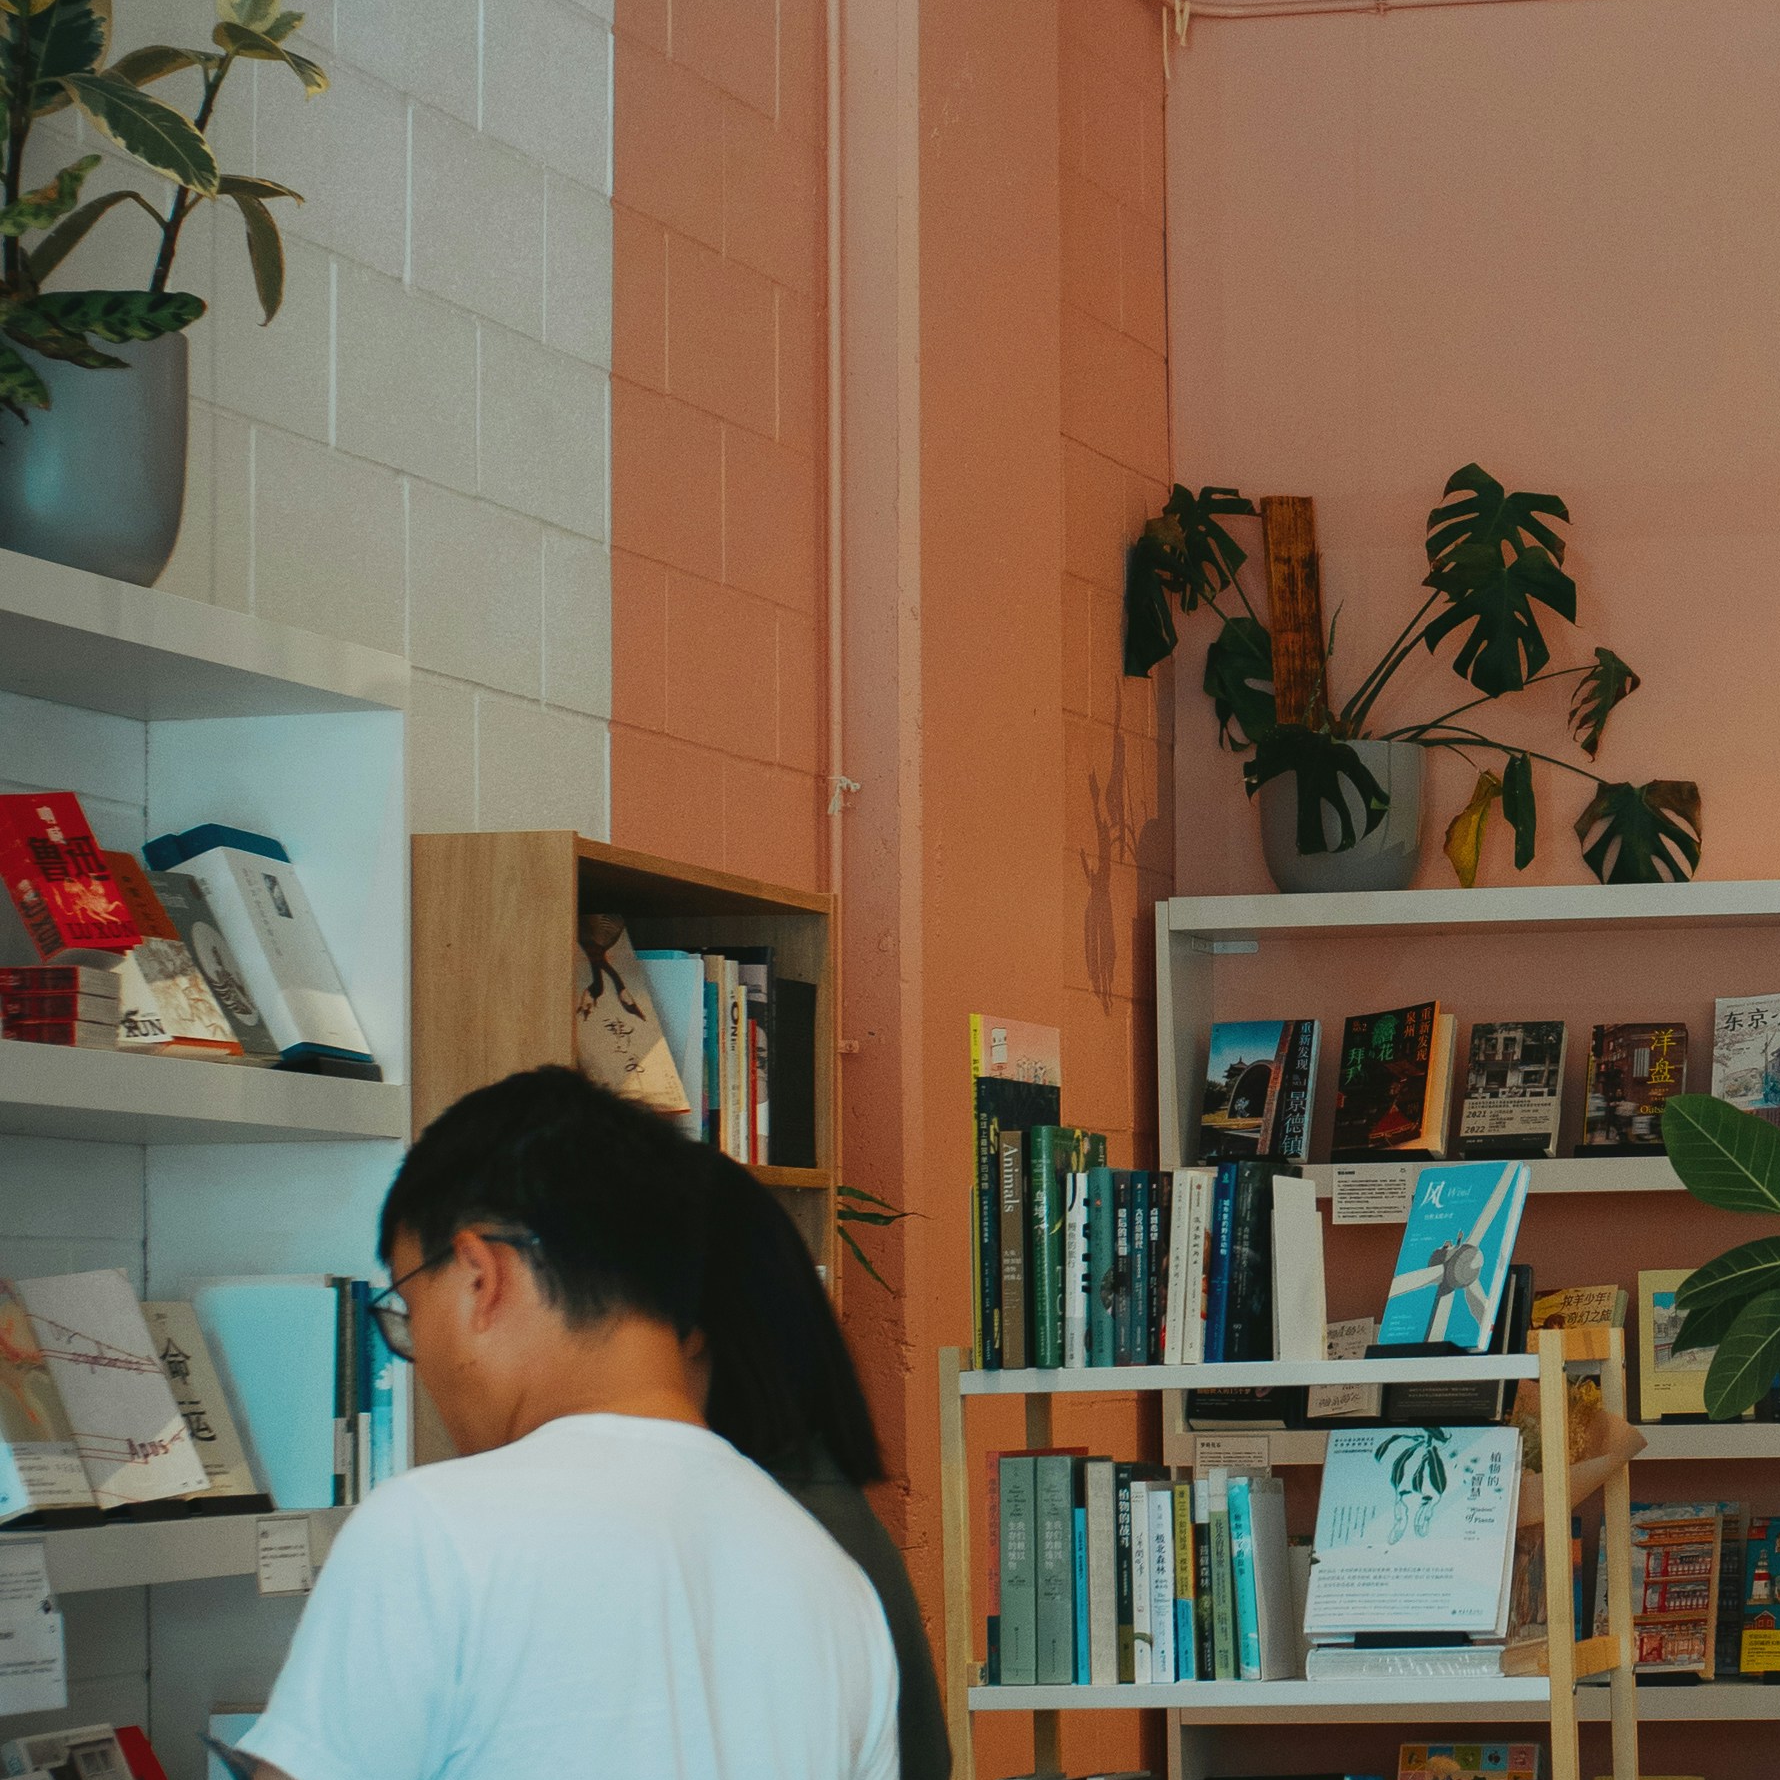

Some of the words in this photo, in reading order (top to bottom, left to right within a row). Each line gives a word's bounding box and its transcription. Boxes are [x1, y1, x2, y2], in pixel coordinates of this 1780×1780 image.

[28, 836, 110, 882] 鲁迅
[1295, 1021, 1313, 1071] 重新发现
[1403, 1011, 1416, 1039] 泉州
[1415, 1006, 1432, 1062] 重新发现
[1646, 1028, 1677, 1085] 洋盘
[1281, 1089, 1307, 1157] 景德镇
[1464, 1125, 1486, 1134] 2022
[1466, 1110, 1487, 1119] 2021
[1003, 1142, 1020, 1214] Animals
[160, 1337, 218, 1443] 命运
[1487, 1451, 1502, 1487] 植物的
